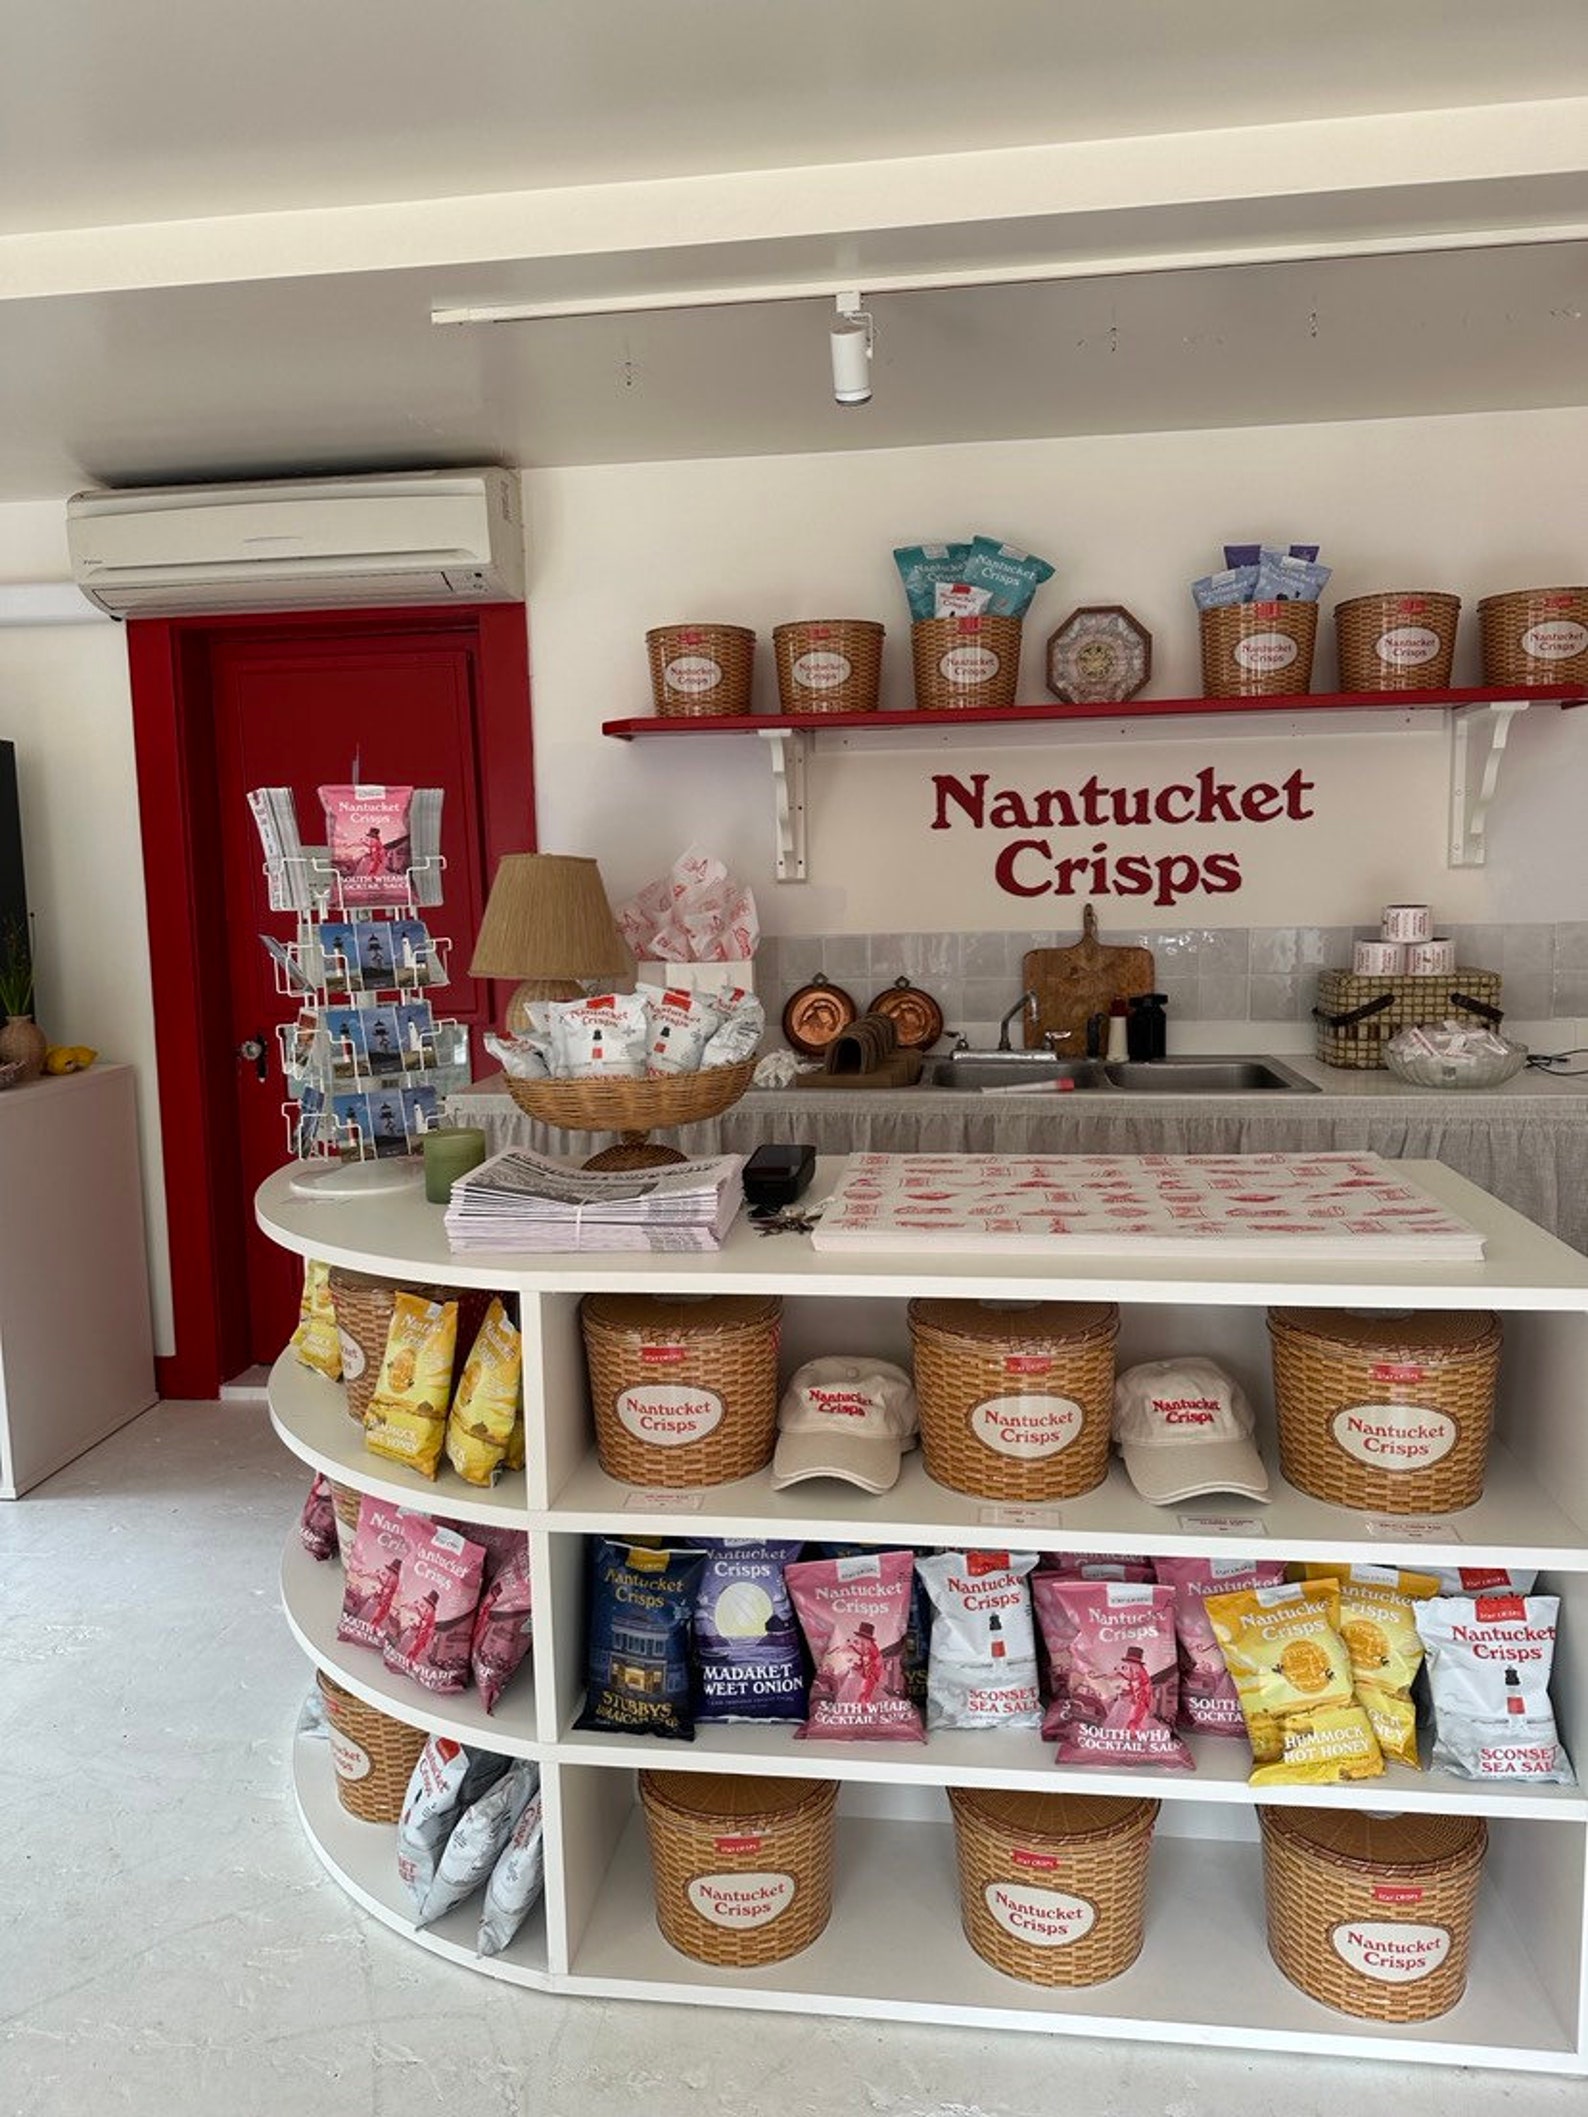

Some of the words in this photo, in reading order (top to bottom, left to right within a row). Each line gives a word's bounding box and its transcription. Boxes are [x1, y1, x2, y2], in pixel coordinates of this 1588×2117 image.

[338, 802, 400, 812] Nantucket
[930, 767, 1316, 830] Nantucket
[350, 812, 391, 825] Crisps
[995, 839, 1244, 906] Crisps
[626, 1398, 711, 1417] Nantucket
[639, 1416, 697, 1434] Crisps
[984, 1409, 1074, 1428] Nantucket
[1347, 1416, 1447, 1438] Nantucket
[1000, 1426, 1060, 1445] Crisps
[1363, 1437, 1430, 1458] Crisps
[377, 1534, 407, 1554] Cris
[705, 1548, 787, 1562] Nantucket
[604, 1567, 685, 1592] Nantucket
[714, 1562, 771, 1579] Crisps
[815, 1581, 904, 1599] Nantucket
[946, 1572, 1026, 1595] Nantucke
[614, 1587, 666, 1609] Crisps
[963, 1591, 1021, 1611] Crisps
[831, 1600, 890, 1616] Crisps
[1239, 1600, 1328, 1630] Nantucke
[1350, 1601, 1401, 1624] risps
[1098, 1625, 1160, 1643] Crisps
[1261, 1618, 1328, 1642] Crisps
[1451, 1625, 1557, 1643] Nantucket
[1472, 1643, 1543, 1663] Crisps
[703, 1663, 793, 1681] MADAKET
[704, 1681, 749, 1696] WEET
[752, 1675, 804, 1695] ONION
[968, 1687, 1037, 1701] SCONSET
[818, 1700, 864, 1714] SOUTH
[968, 1700, 999, 1714] SEA
[1002, 1700, 1041, 1714] SALT
[1190, 1710, 1244, 1723] COCKTA
[814, 1712, 876, 1725] COCKTAIL
[1078, 1723, 1132, 1741] SOUTH
[1135, 1728, 1172, 1742] WHA
[1284, 1726, 1365, 1748] HUMMOCK
[1078, 1736, 1145, 1752] COCKTAIL
[1284, 1747, 1317, 1764] HOT
[1320, 1738, 1371, 1757] HONEY
[1480, 1744, 1559, 1762] SCONSET
[1481, 1761, 1518, 1774] SEA
[699, 1883, 786, 1902] Nantucket
[714, 1901, 772, 1918] Crisps
[995, 1890, 1084, 1921] Nantucket
[1008, 1912, 1070, 1937] Crisps
[1346, 1930, 1442, 1954] Nantucket
[1363, 1951, 1427, 1972] Crisps
